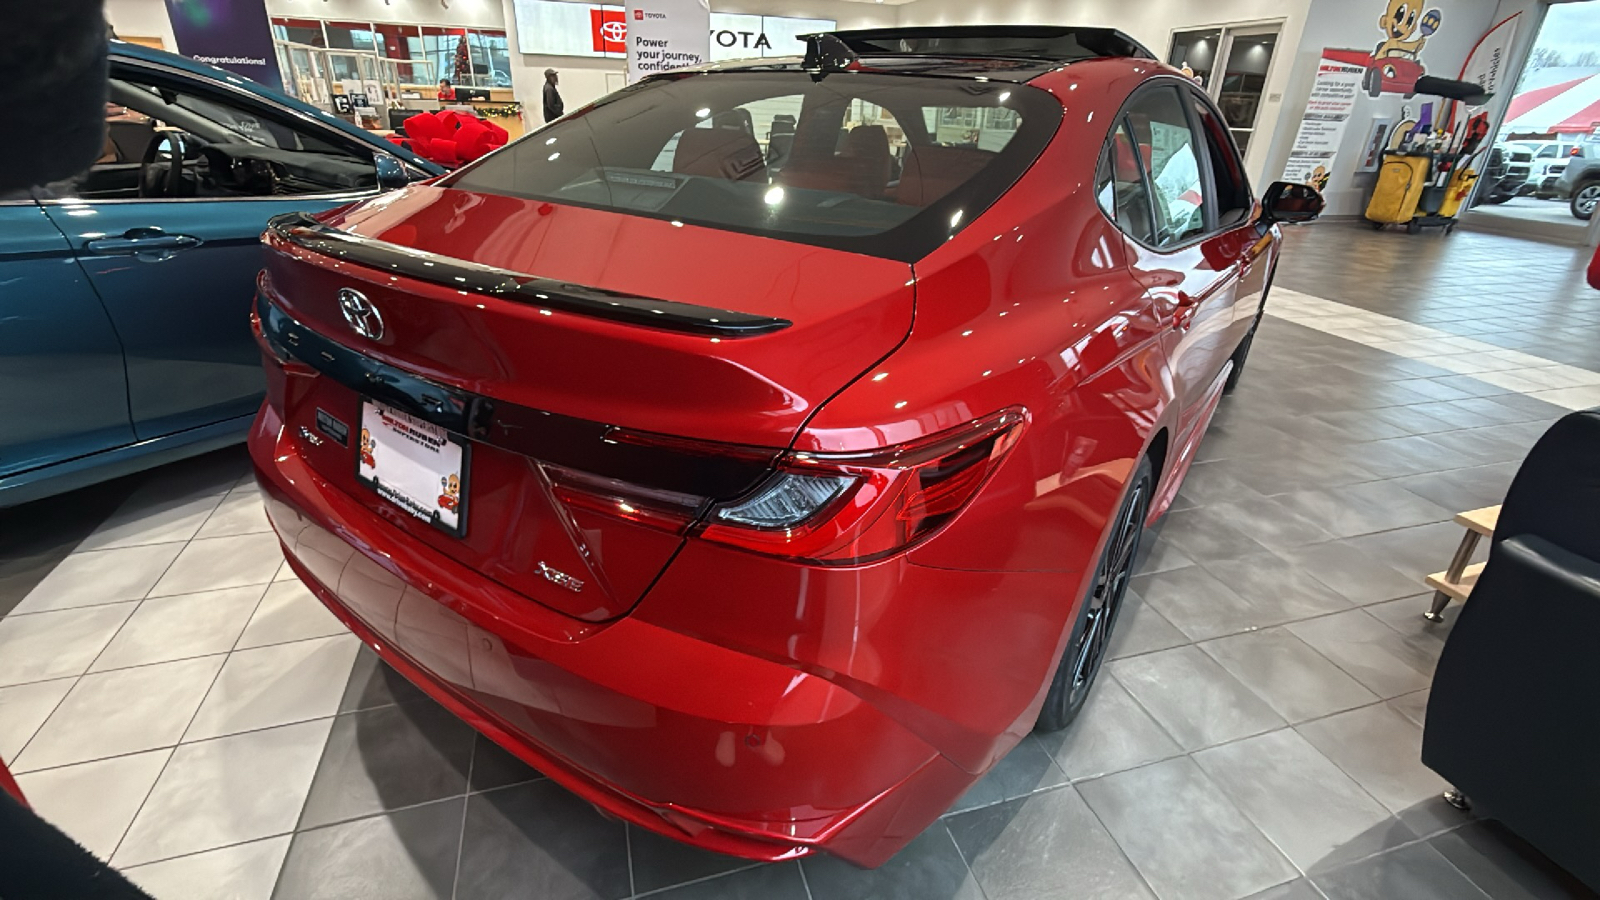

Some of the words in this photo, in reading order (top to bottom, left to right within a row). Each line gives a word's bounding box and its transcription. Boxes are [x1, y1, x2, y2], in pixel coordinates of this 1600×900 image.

[636, 36, 668, 47] Power
[193, 55, 266, 65] Congratulations!
[637, 50, 660, 60] your
[661, 49, 702, 64] journey,
[534, 560, 584, 593] XSE
